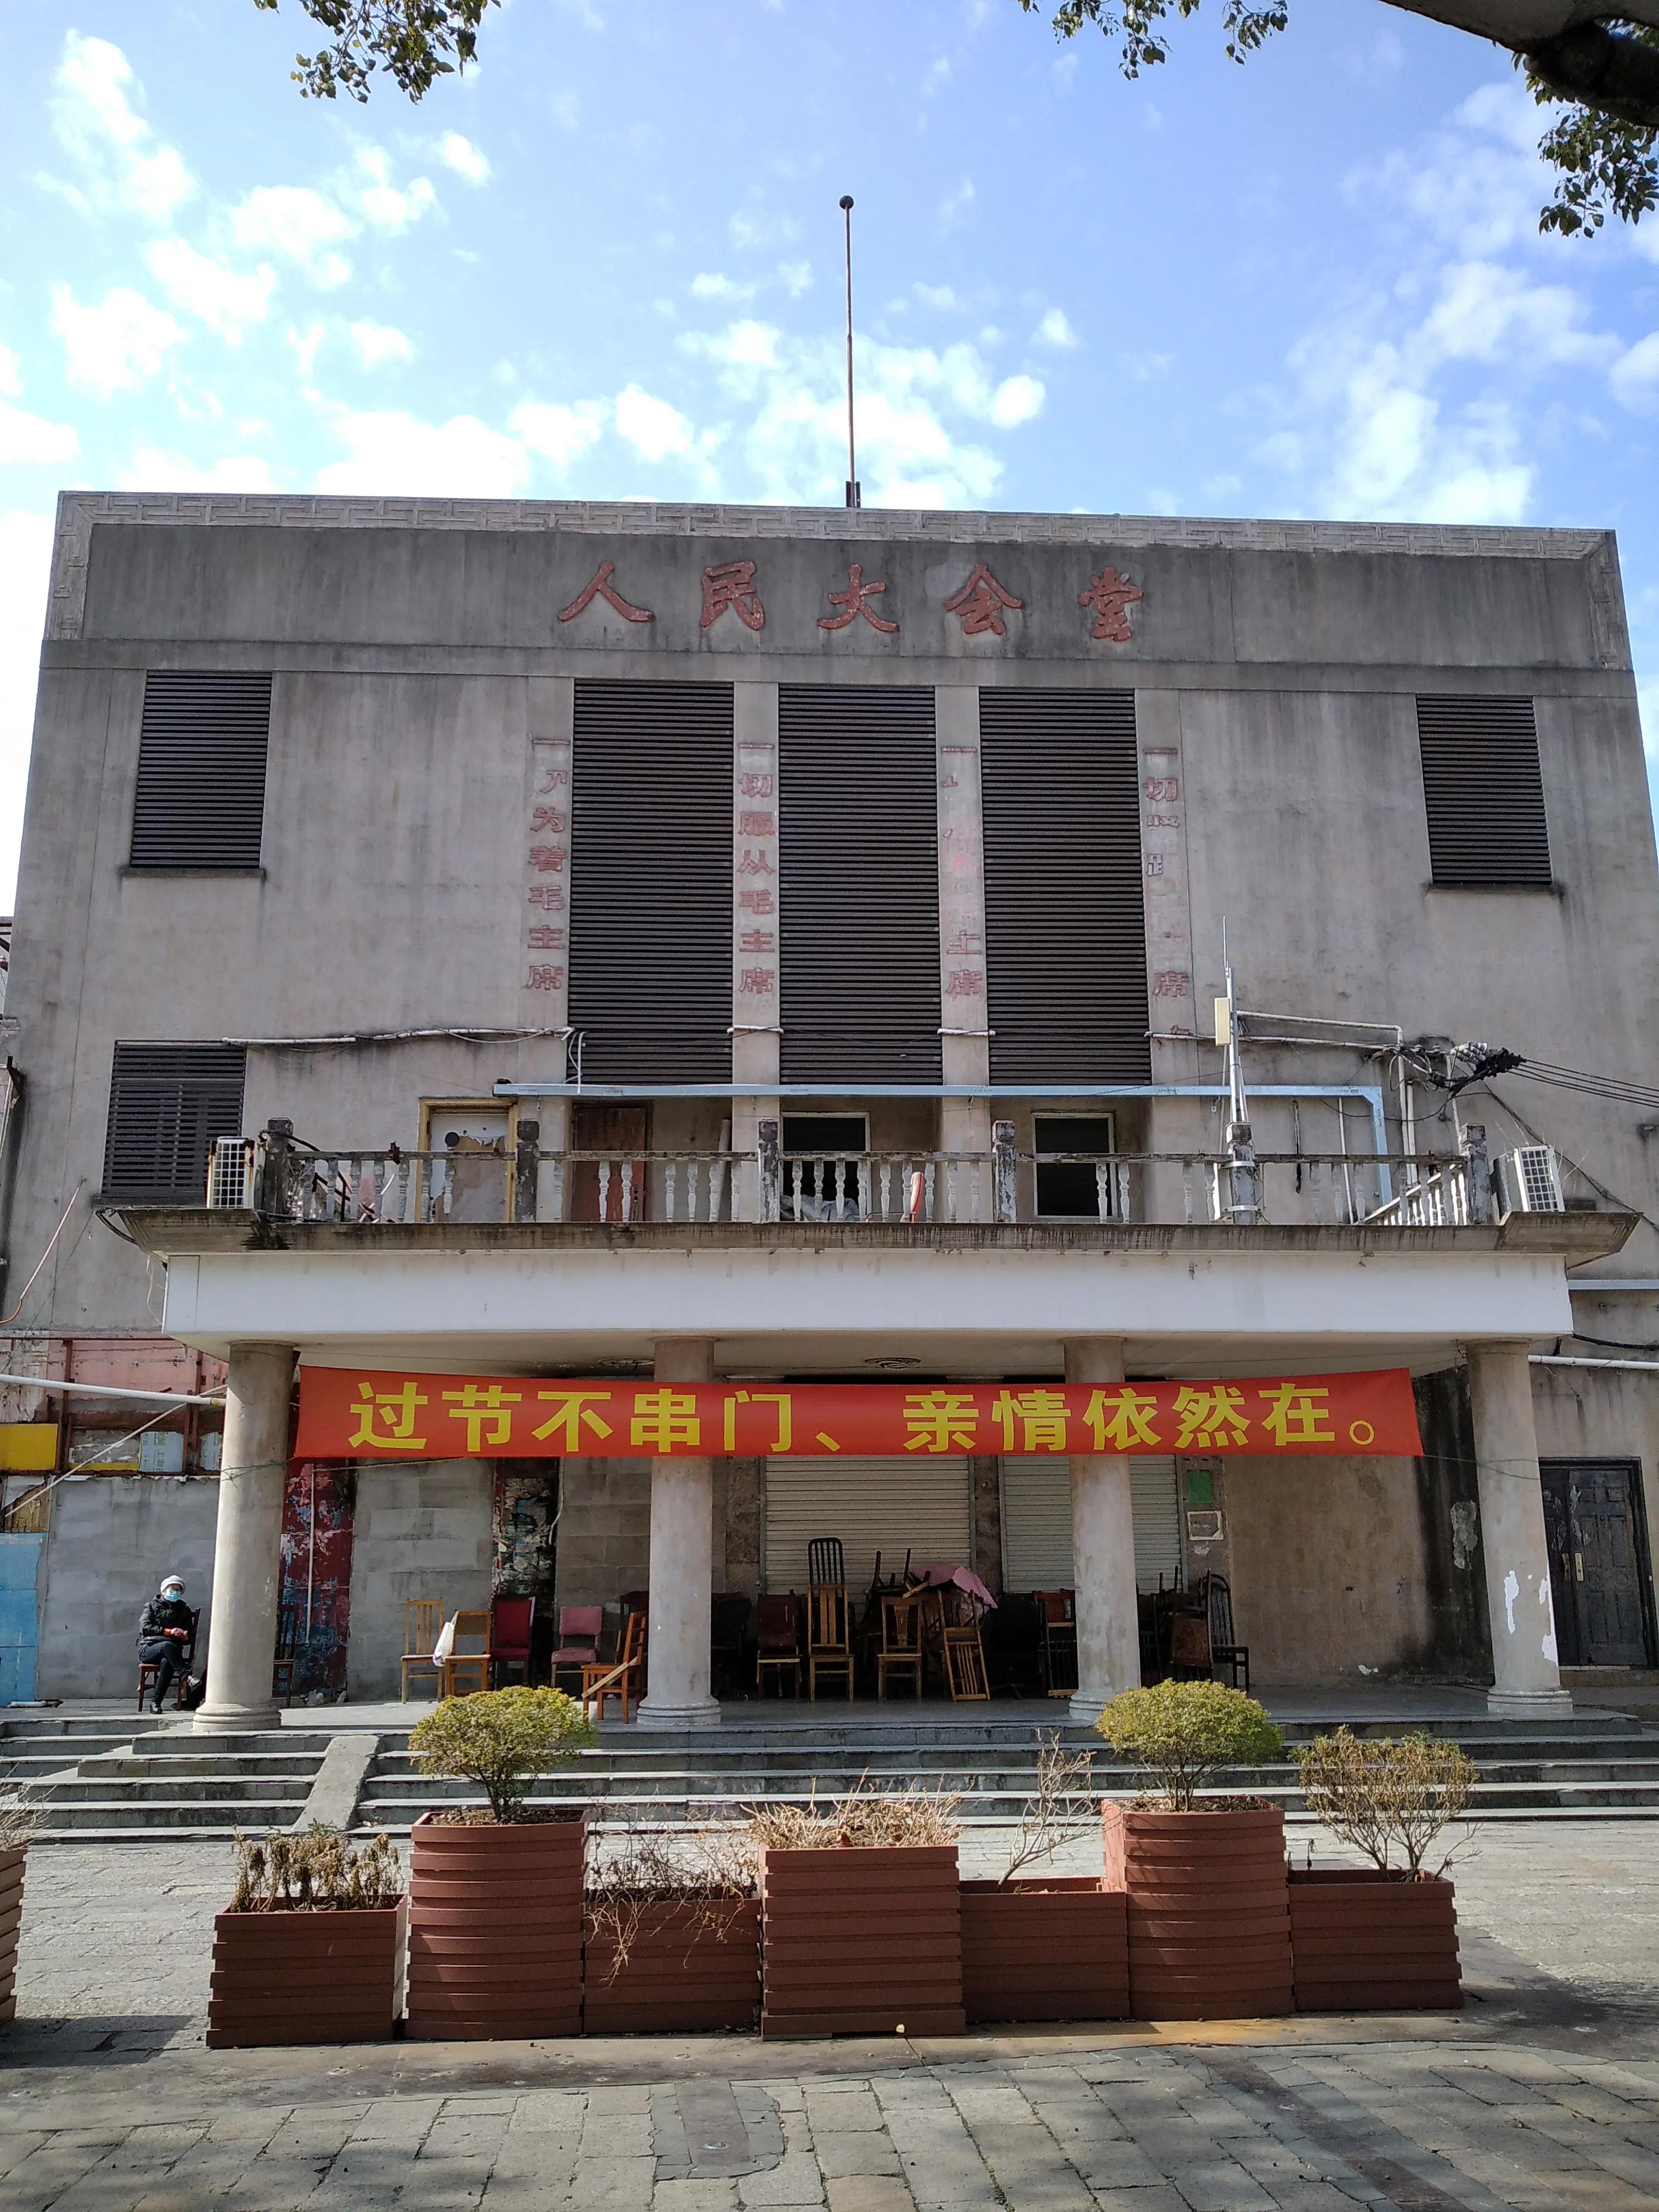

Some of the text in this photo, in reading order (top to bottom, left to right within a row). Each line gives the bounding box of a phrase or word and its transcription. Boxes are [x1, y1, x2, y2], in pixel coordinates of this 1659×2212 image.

[557, 561, 1143, 642] 人民大会堂
[737, 742, 775, 993] 一切服从毛主席
[348, 1381, 1375, 1453] 过节不串门、亲情依然在。
